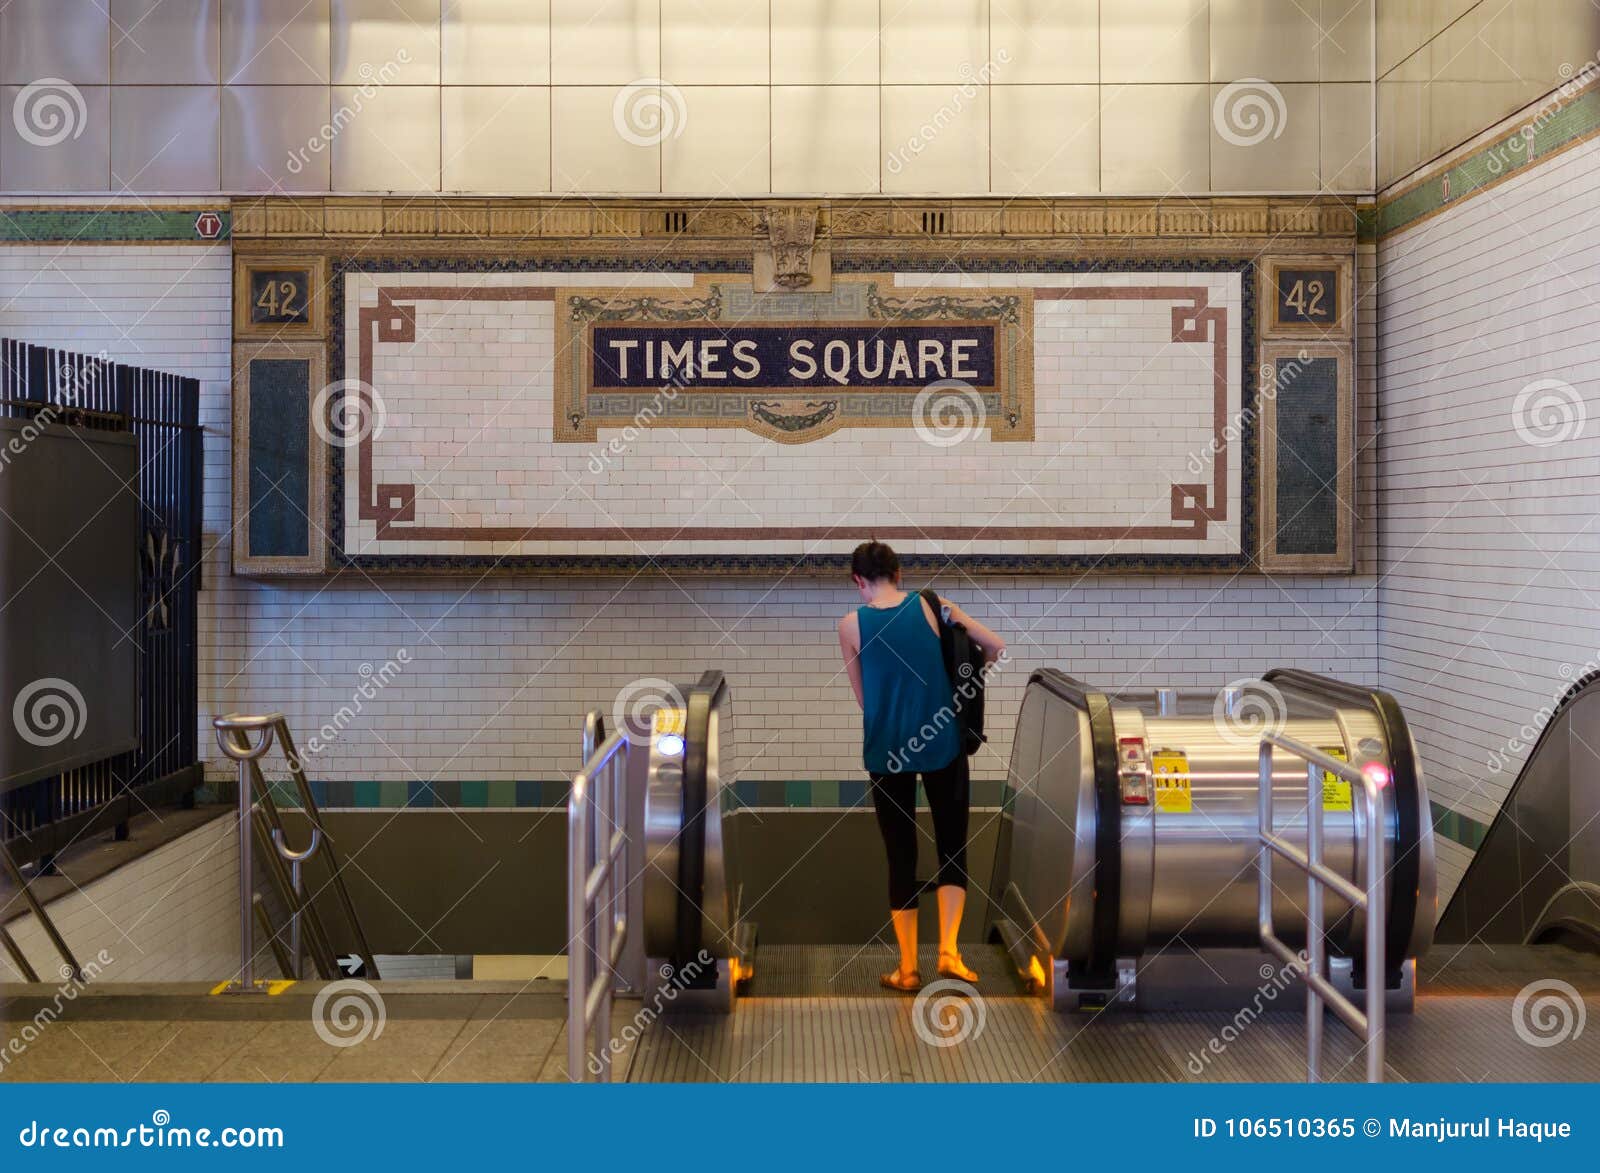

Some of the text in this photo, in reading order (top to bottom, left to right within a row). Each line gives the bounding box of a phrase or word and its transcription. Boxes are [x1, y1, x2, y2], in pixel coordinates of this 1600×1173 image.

[201, 217, 216, 235] T
[257, 280, 300, 316] 42
[1285, 280, 1328, 316] 42
[609, 339, 979, 385] TIMES SQUARE
